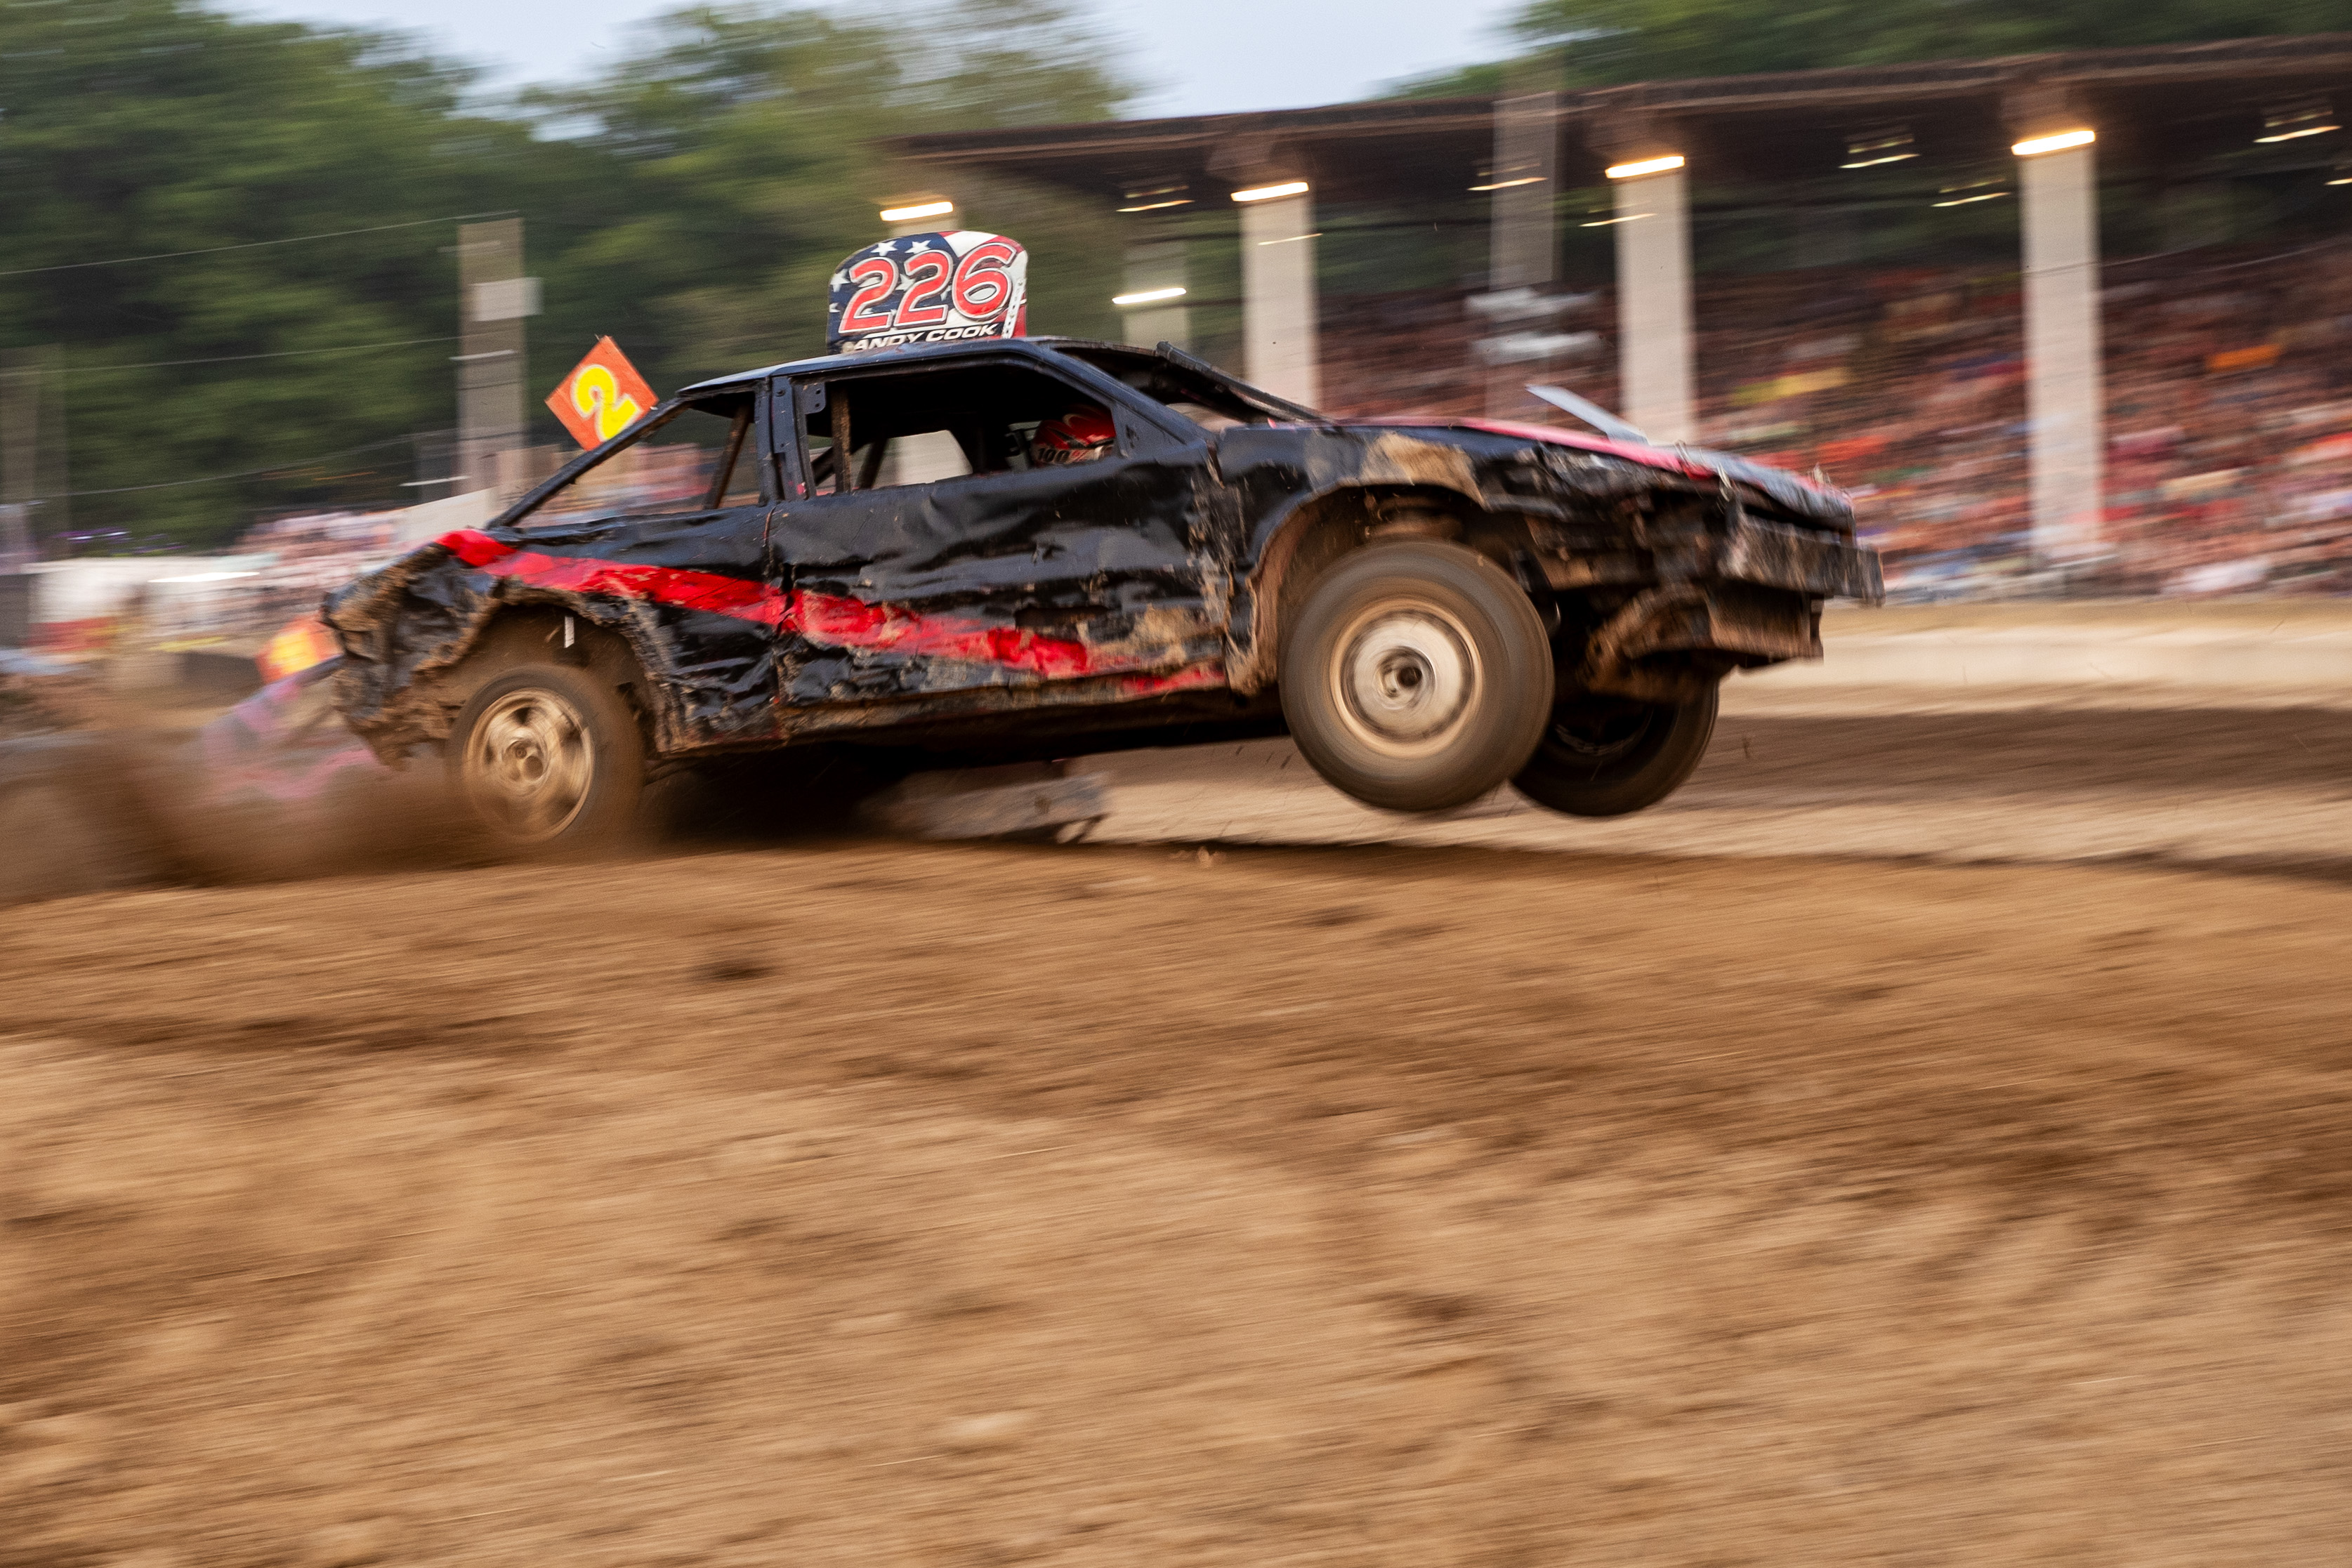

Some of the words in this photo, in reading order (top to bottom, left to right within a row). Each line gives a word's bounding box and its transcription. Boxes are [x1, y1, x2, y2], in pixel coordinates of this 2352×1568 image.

[838, 242, 1016, 335] 226
[926, 324, 999, 342] COOK
[570, 364, 644, 442] 2
